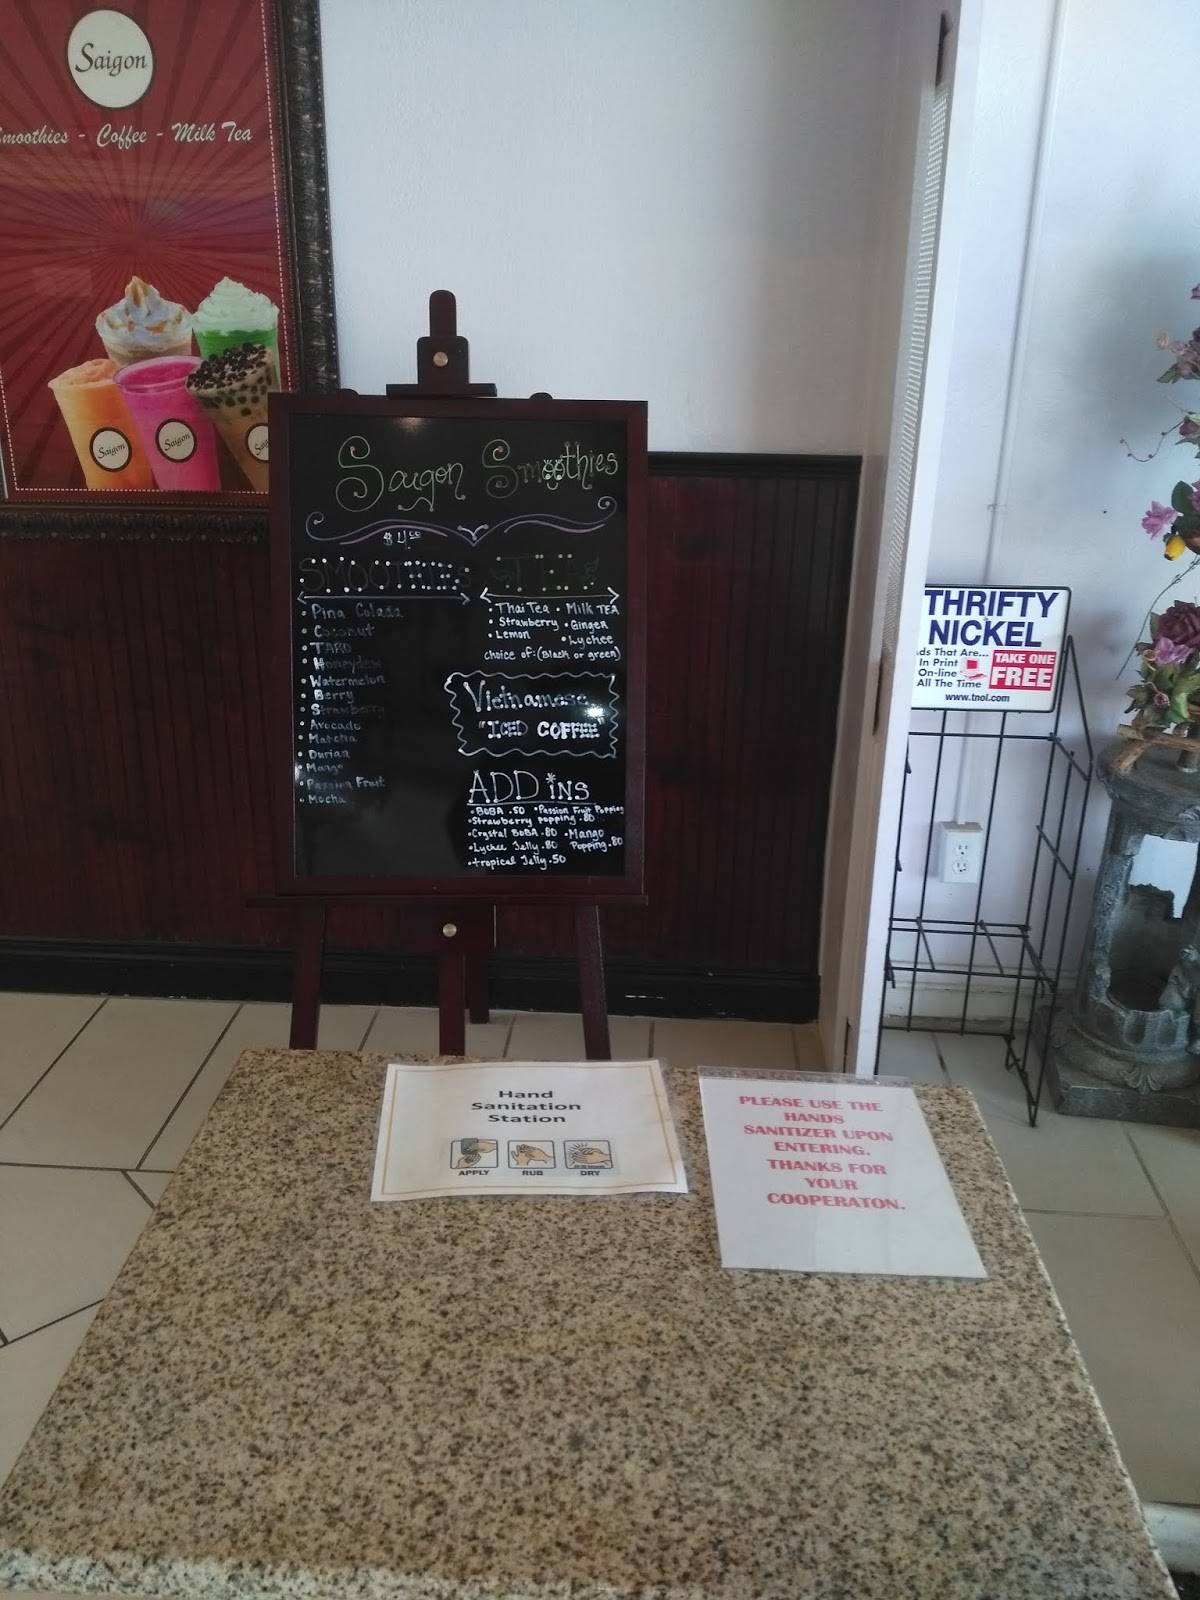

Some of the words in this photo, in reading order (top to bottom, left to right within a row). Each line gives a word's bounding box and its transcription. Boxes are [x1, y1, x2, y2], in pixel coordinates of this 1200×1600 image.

[75, 42, 147, 77] Saigon
[96, 123, 147, 150] Coffee
[171, 122, 216, 142] Milk
[221, 121, 252, 142] Tea
[164, 432, 191, 451] Saigon
[97, 443, 126, 459] Saigon
[336, 436, 465, 512] Saigon
[482, 439, 618, 498] Smoothies
[495, 602, 525, 614] Thai
[526, 602, 550, 614] Tea
[566, 602, 594, 615] Milk
[596, 604, 620, 615] TEA
[925, 590, 1059, 617] THRIFTY
[312, 603, 346, 620] Pina
[499, 617, 559, 631] Strawberry
[495, 630, 531, 640] Lemon
[929, 620, 1042, 647] NICKEL
[569, 635, 614, 649] Lychee
[588, 646, 622, 661] green)
[916, 648, 931, 656] ds
[935, 647, 957, 656] That
[960, 649, 989, 657] Are...
[994, 653, 1025, 664] TAKE
[1029, 653, 1055, 665] ONE
[933, 658, 958, 667] Print
[918, 668, 957, 677] On-line
[991, 667, 1053, 688] FREE
[310, 673, 385, 688] Watermelon
[917, 679, 931, 687] All
[935, 679, 953, 687] The
[957, 679, 982, 688] Time
[314, 689, 354, 704] Berry
[463, 680, 589, 712] Vietnamese
[945, 693, 1010, 702] www.tnol.com
[310, 719, 361, 731] Avocado
[308, 733, 358, 744] Matcha
[308, 749, 350, 760] Durian
[355, 776, 385, 788] Fruit
[468, 770, 540, 803] ADD
[308, 794, 346, 804] Mocha
[538, 804, 569, 814] Passion
[573, 806, 592, 814] Fruit
[472, 816, 532, 828] Strawberry
[472, 828, 507, 841] Crystal
[568, 828, 605, 841] Mango
[473, 842, 507, 855] Lychee
[512, 840, 540, 855] Jelly
[569, 841, 608, 853] Popping
[520, 854, 548, 870] Jelly
[499, 1090, 554, 1099] Hand
[471, 1102, 582, 1111] Sanitation
[739, 1096, 804, 1108] PLEASE
[809, 1098, 843, 1110] USE
[847, 1101, 884, 1112] THE
[488, 1114, 567, 1124] Station
[784, 1112, 845, 1124] HANDS
[743, 1124, 836, 1139] SANITIZER
[843, 1129, 894, 1142] UPON
[774, 1141, 871, 1156] ENTERING.
[766, 1159, 843, 1173] THANKS
[848, 1163, 888, 1175] FOR
[805, 1177, 859, 1191] YOUR
[766, 1192, 906, 1210] COOPERATON.
